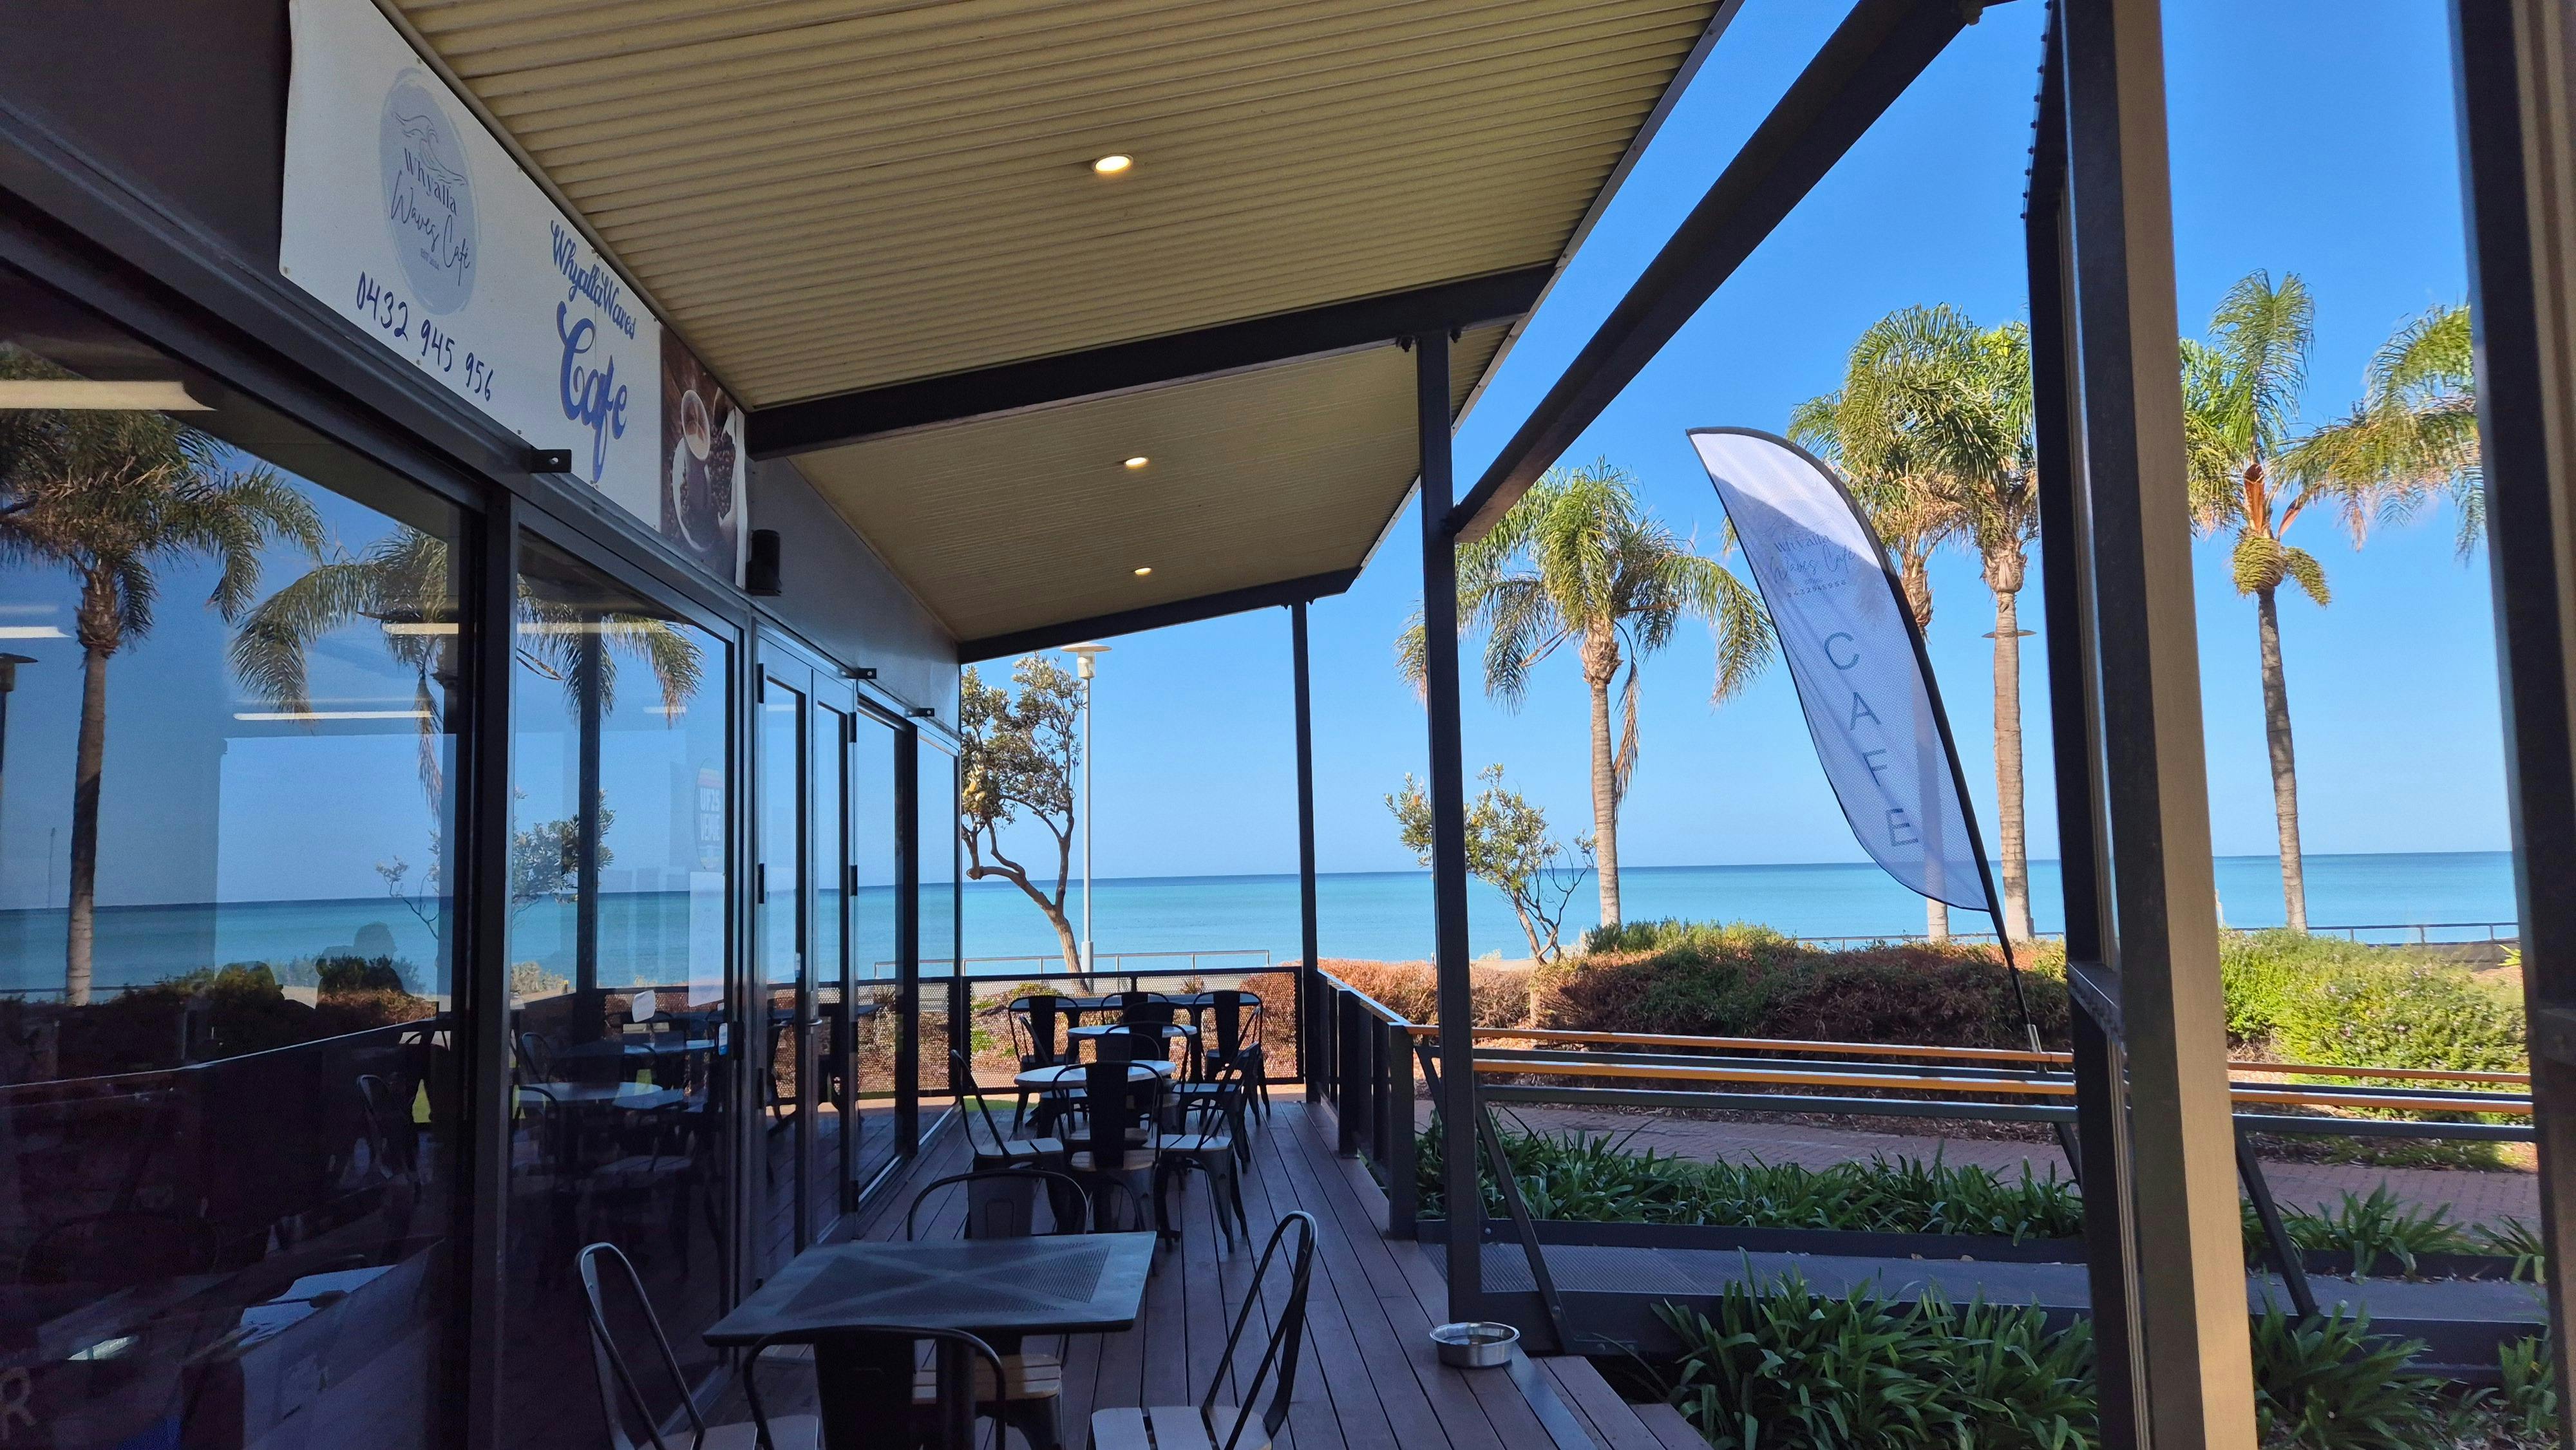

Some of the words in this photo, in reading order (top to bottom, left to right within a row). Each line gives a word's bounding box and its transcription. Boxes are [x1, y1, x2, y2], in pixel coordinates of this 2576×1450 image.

[391, 170, 439, 252] Waves
[404, 148, 457, 216] Whyalla
[357, 270, 408, 341] 0432
[421, 319, 455, 372] 945
[466, 352, 493, 402] 956
[556, 300, 627, 483] Cafe
[1824, 632, 1918, 847] CAFE
